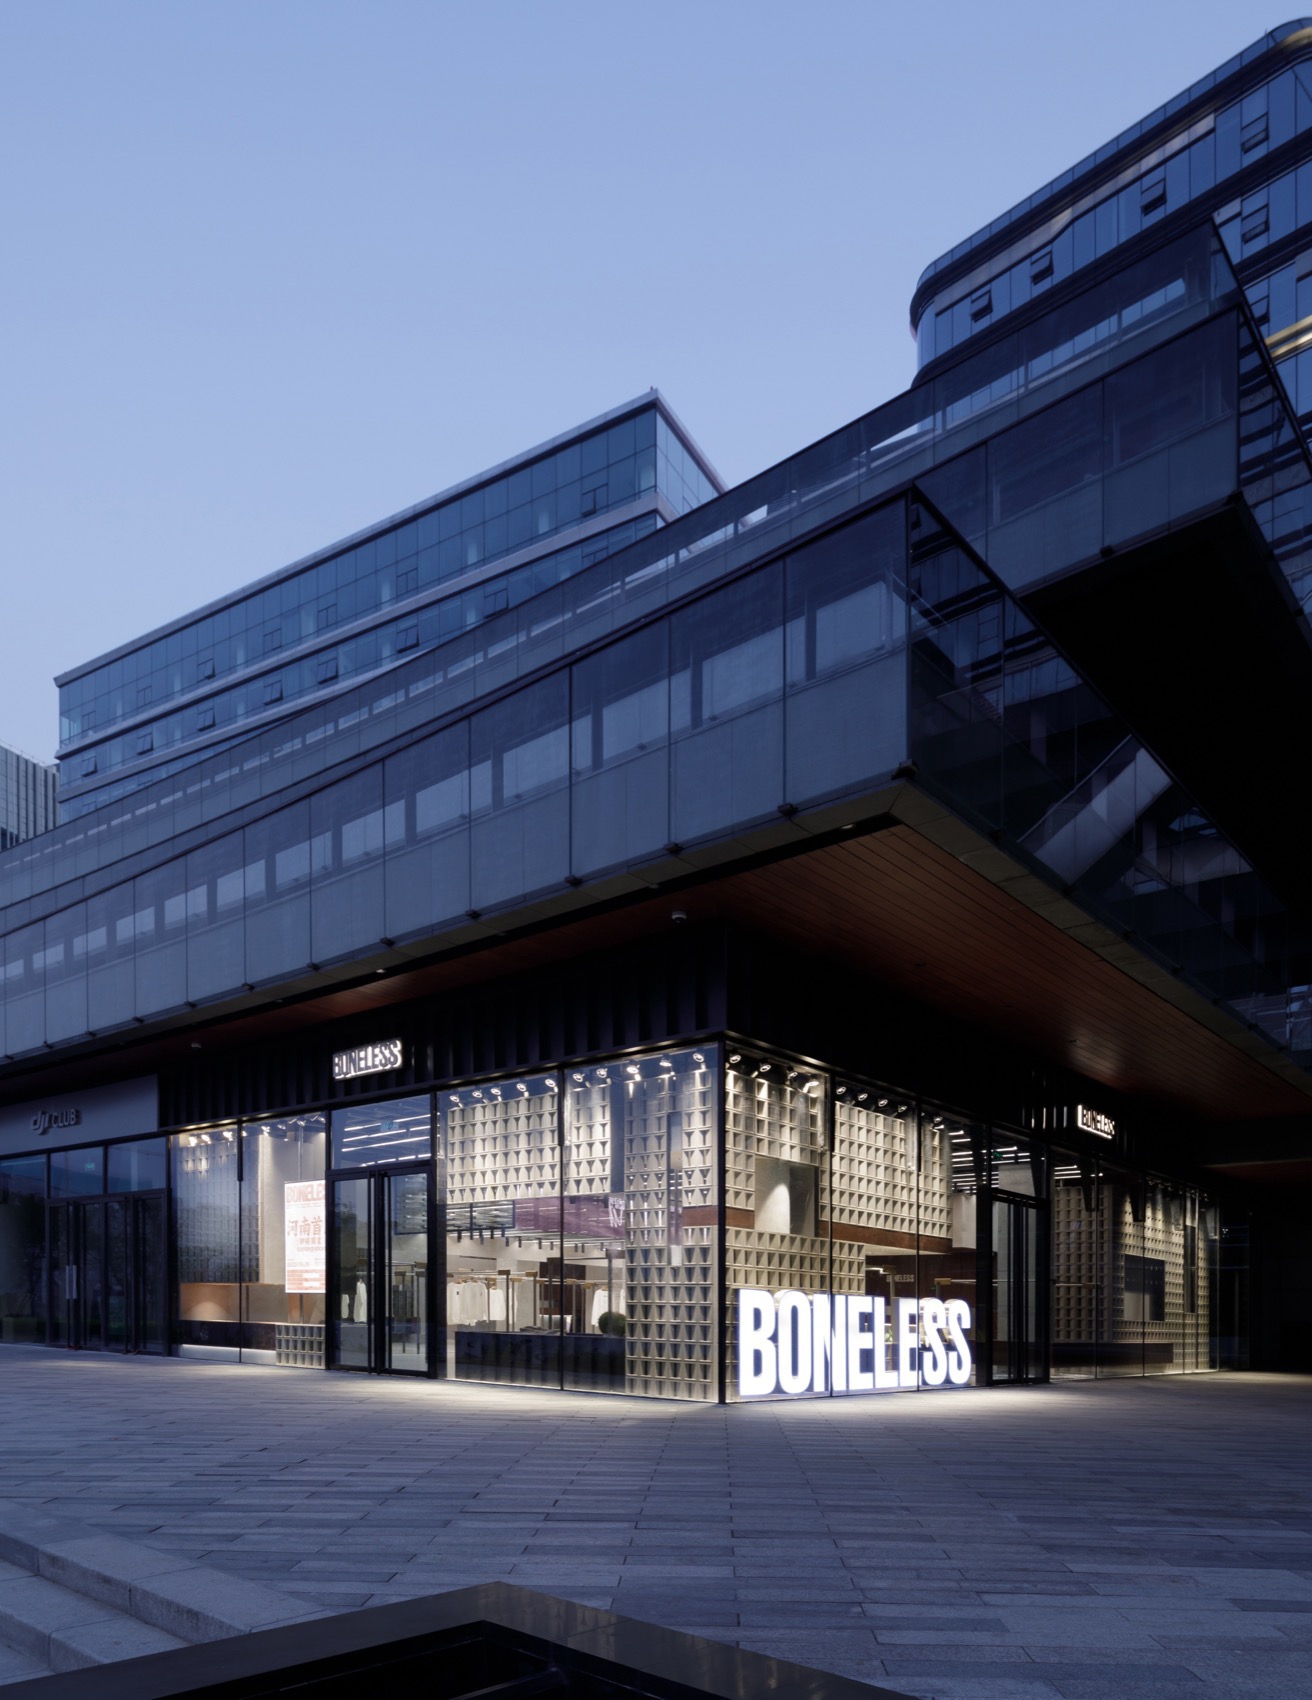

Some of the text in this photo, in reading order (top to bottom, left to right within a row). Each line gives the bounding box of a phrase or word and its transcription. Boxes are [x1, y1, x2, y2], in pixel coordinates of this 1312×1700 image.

[332, 1038, 402, 1079] BONELESS
[51, 1109, 77, 1128] CLUB
[1078, 1104, 1116, 1139] BONELESS
[286, 1183, 325, 1203] BONELE
[886, 1274, 915, 1283] BNELESS
[739, 1288, 972, 1396] BONELESS
